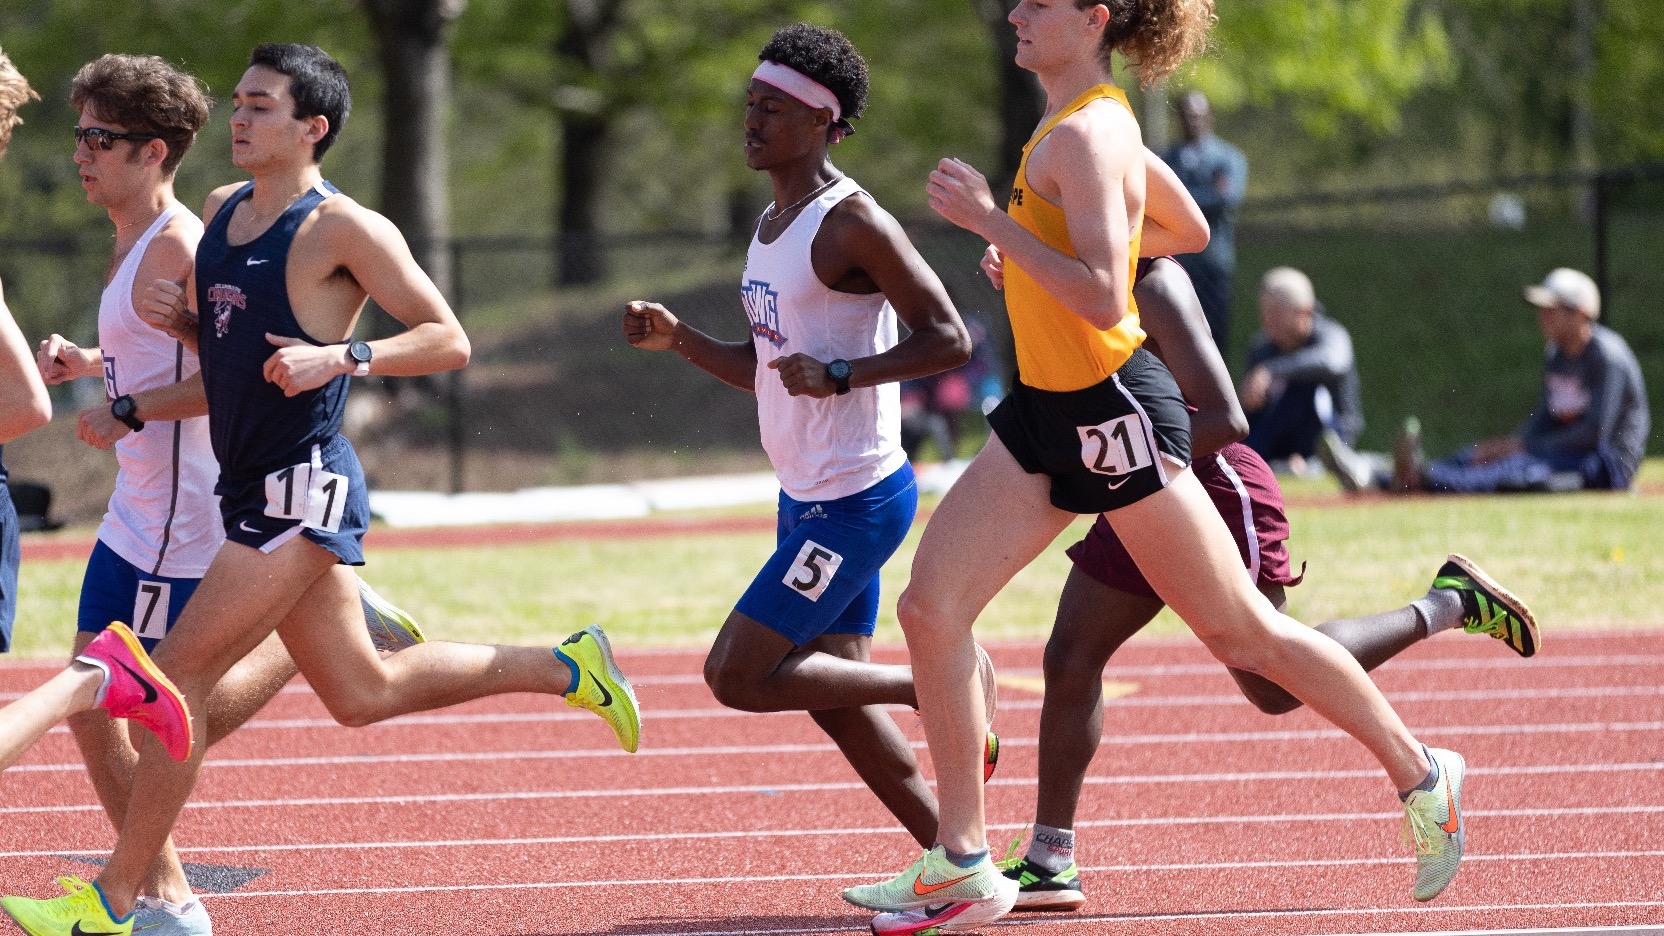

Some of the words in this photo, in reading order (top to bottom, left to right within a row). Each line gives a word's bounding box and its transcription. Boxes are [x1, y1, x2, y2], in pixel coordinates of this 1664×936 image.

[1086, 420, 1138, 473] 21
[791, 546, 833, 591] 5
[138, 584, 162, 634] 7
